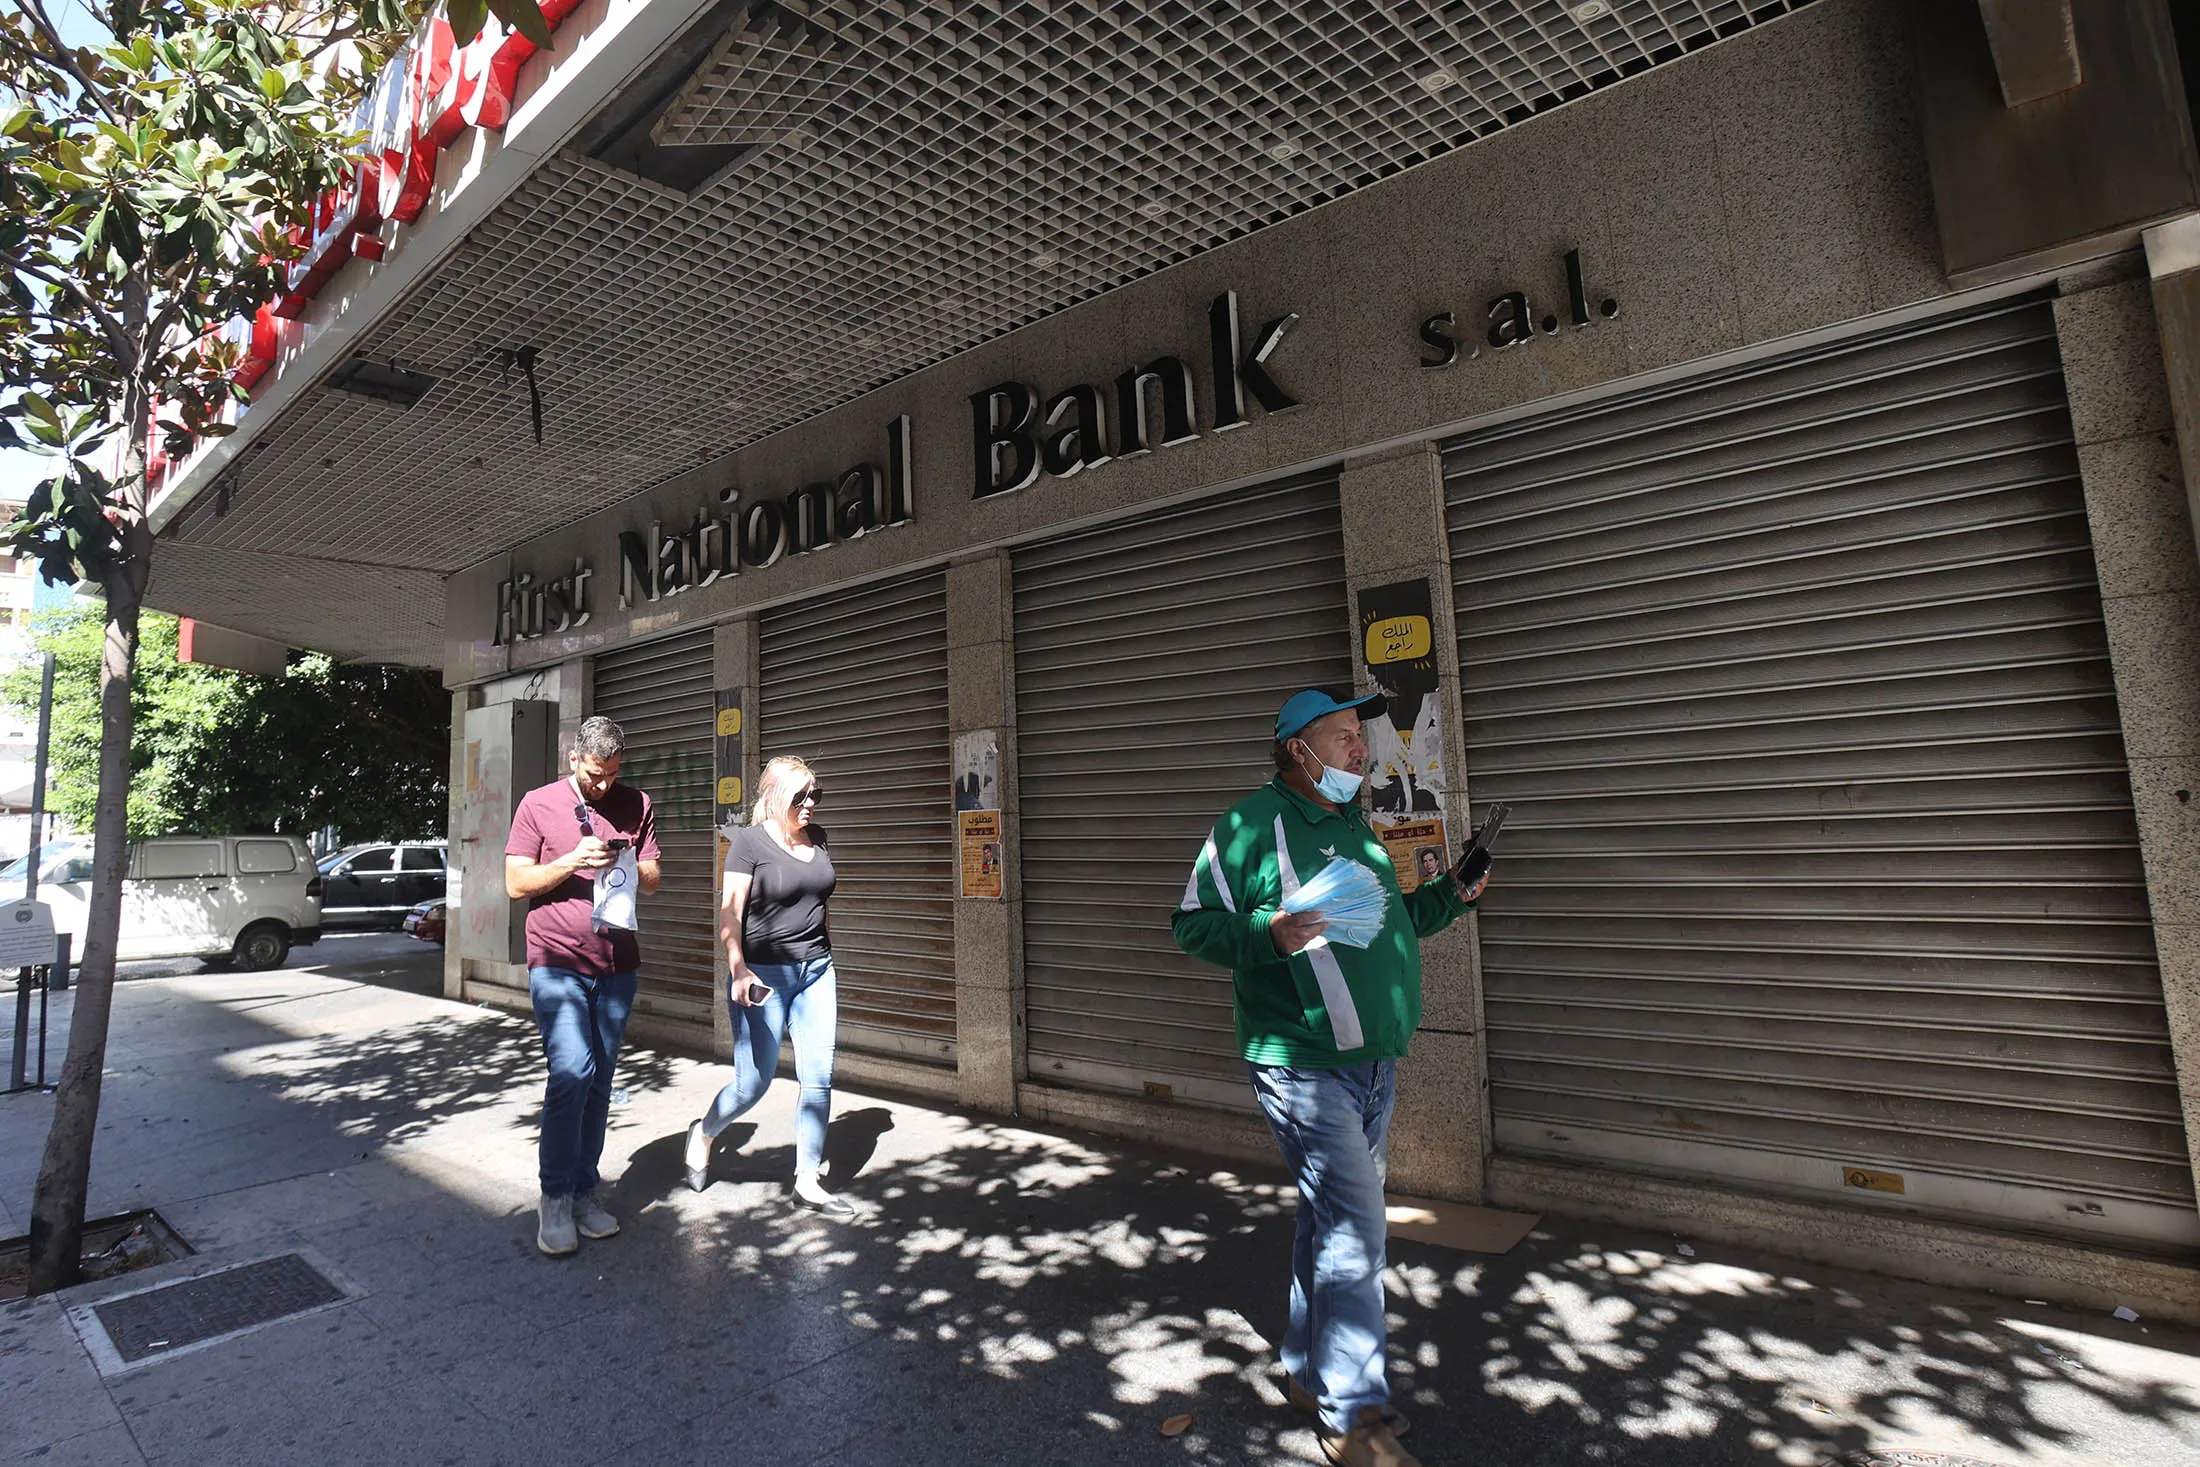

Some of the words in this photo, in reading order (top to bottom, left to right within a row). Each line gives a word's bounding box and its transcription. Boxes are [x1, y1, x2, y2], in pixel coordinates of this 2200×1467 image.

[493, 557, 592, 646] First
[619, 414, 914, 611] National
[969, 288, 1302, 501] Bank
[1419, 247, 1619, 371] s.a.l.
[1384, 637, 1414, 660] راجع
